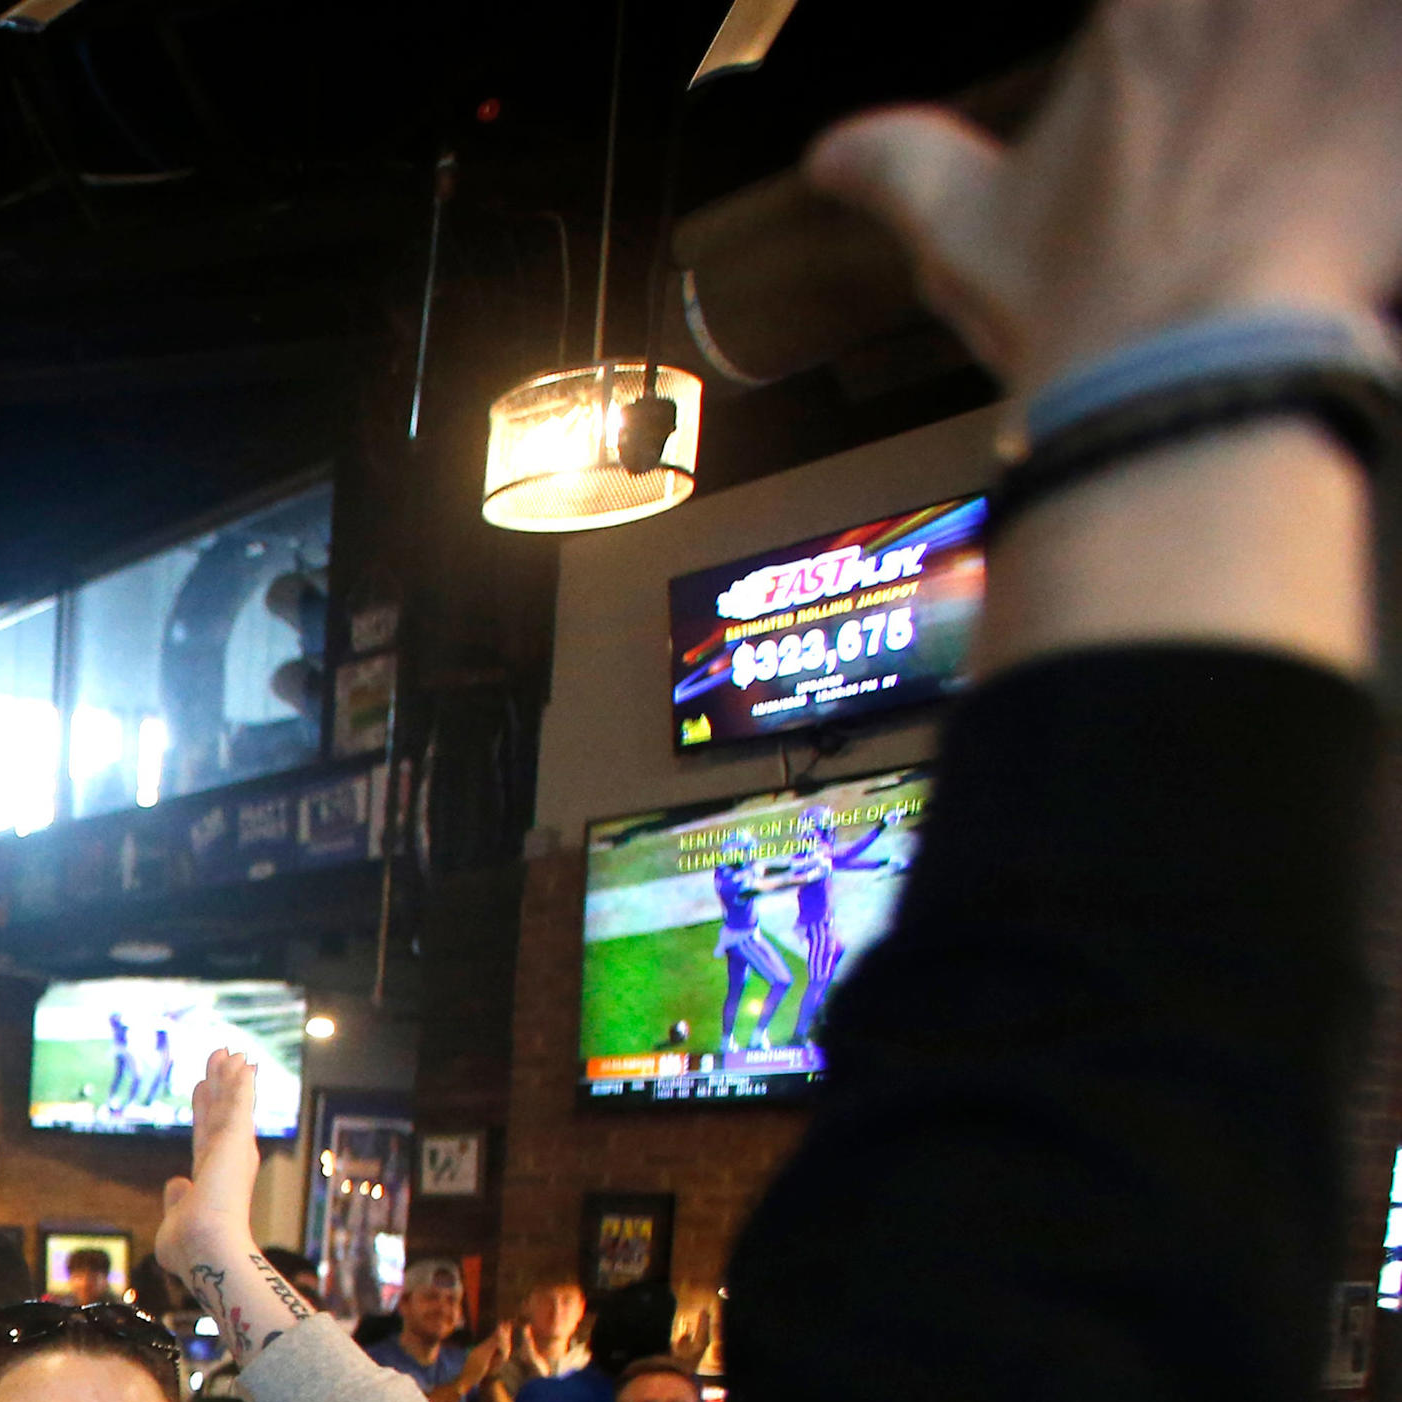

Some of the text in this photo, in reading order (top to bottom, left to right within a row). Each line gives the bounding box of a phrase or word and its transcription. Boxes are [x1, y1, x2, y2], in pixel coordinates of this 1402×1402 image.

[725, 581, 920, 642] ESTIMATED ROLLING JACKPOT
[679, 823, 755, 851] KENTUCKY
[760, 821, 782, 837] ON
[788, 816, 816, 834] THE
[822, 808, 861, 827] EDGE
[867, 805, 886, 822] OF
[678, 837, 821, 872] CLEMSON RED ZONE
